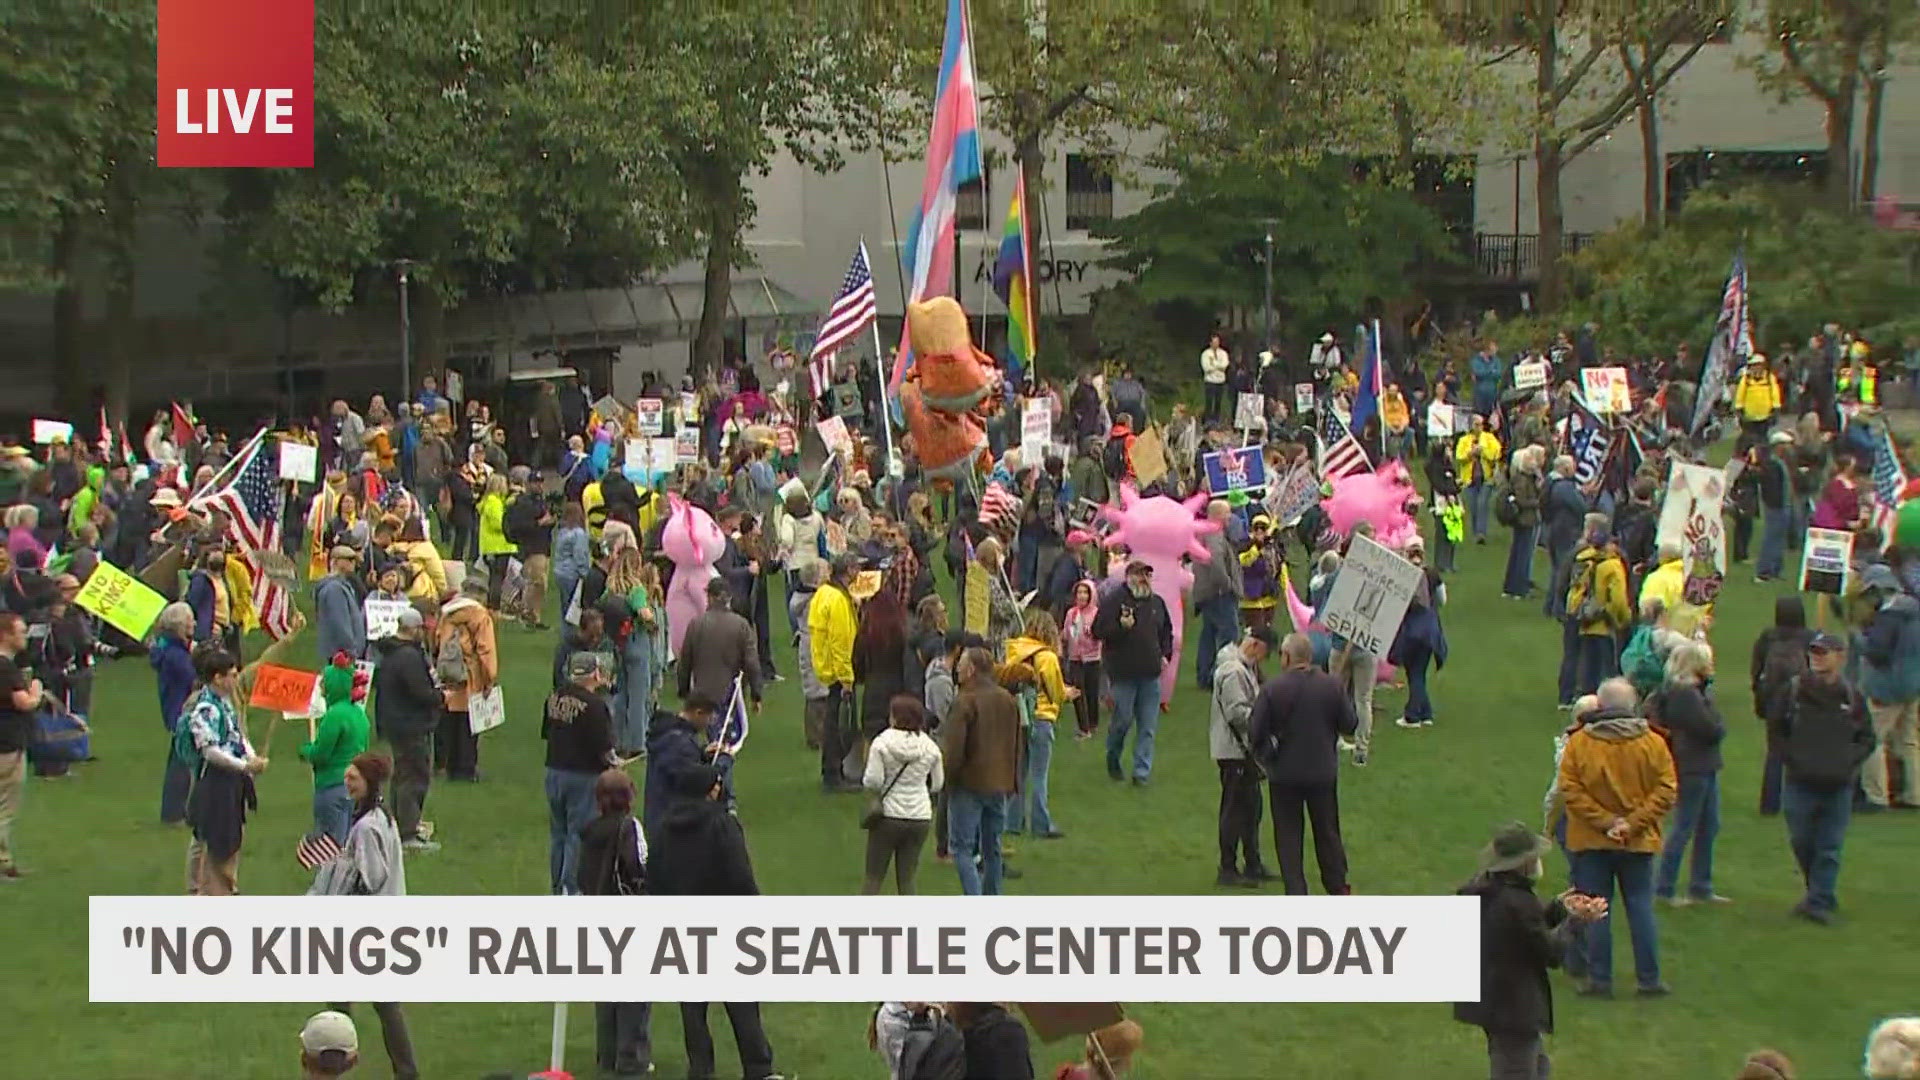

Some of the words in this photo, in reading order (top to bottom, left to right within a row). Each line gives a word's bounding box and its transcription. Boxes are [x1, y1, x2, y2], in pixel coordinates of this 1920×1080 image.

[85, 574, 108, 599] NO
[94, 572, 131, 616] KINGS
[1326, 612, 1382, 655] SPINE
